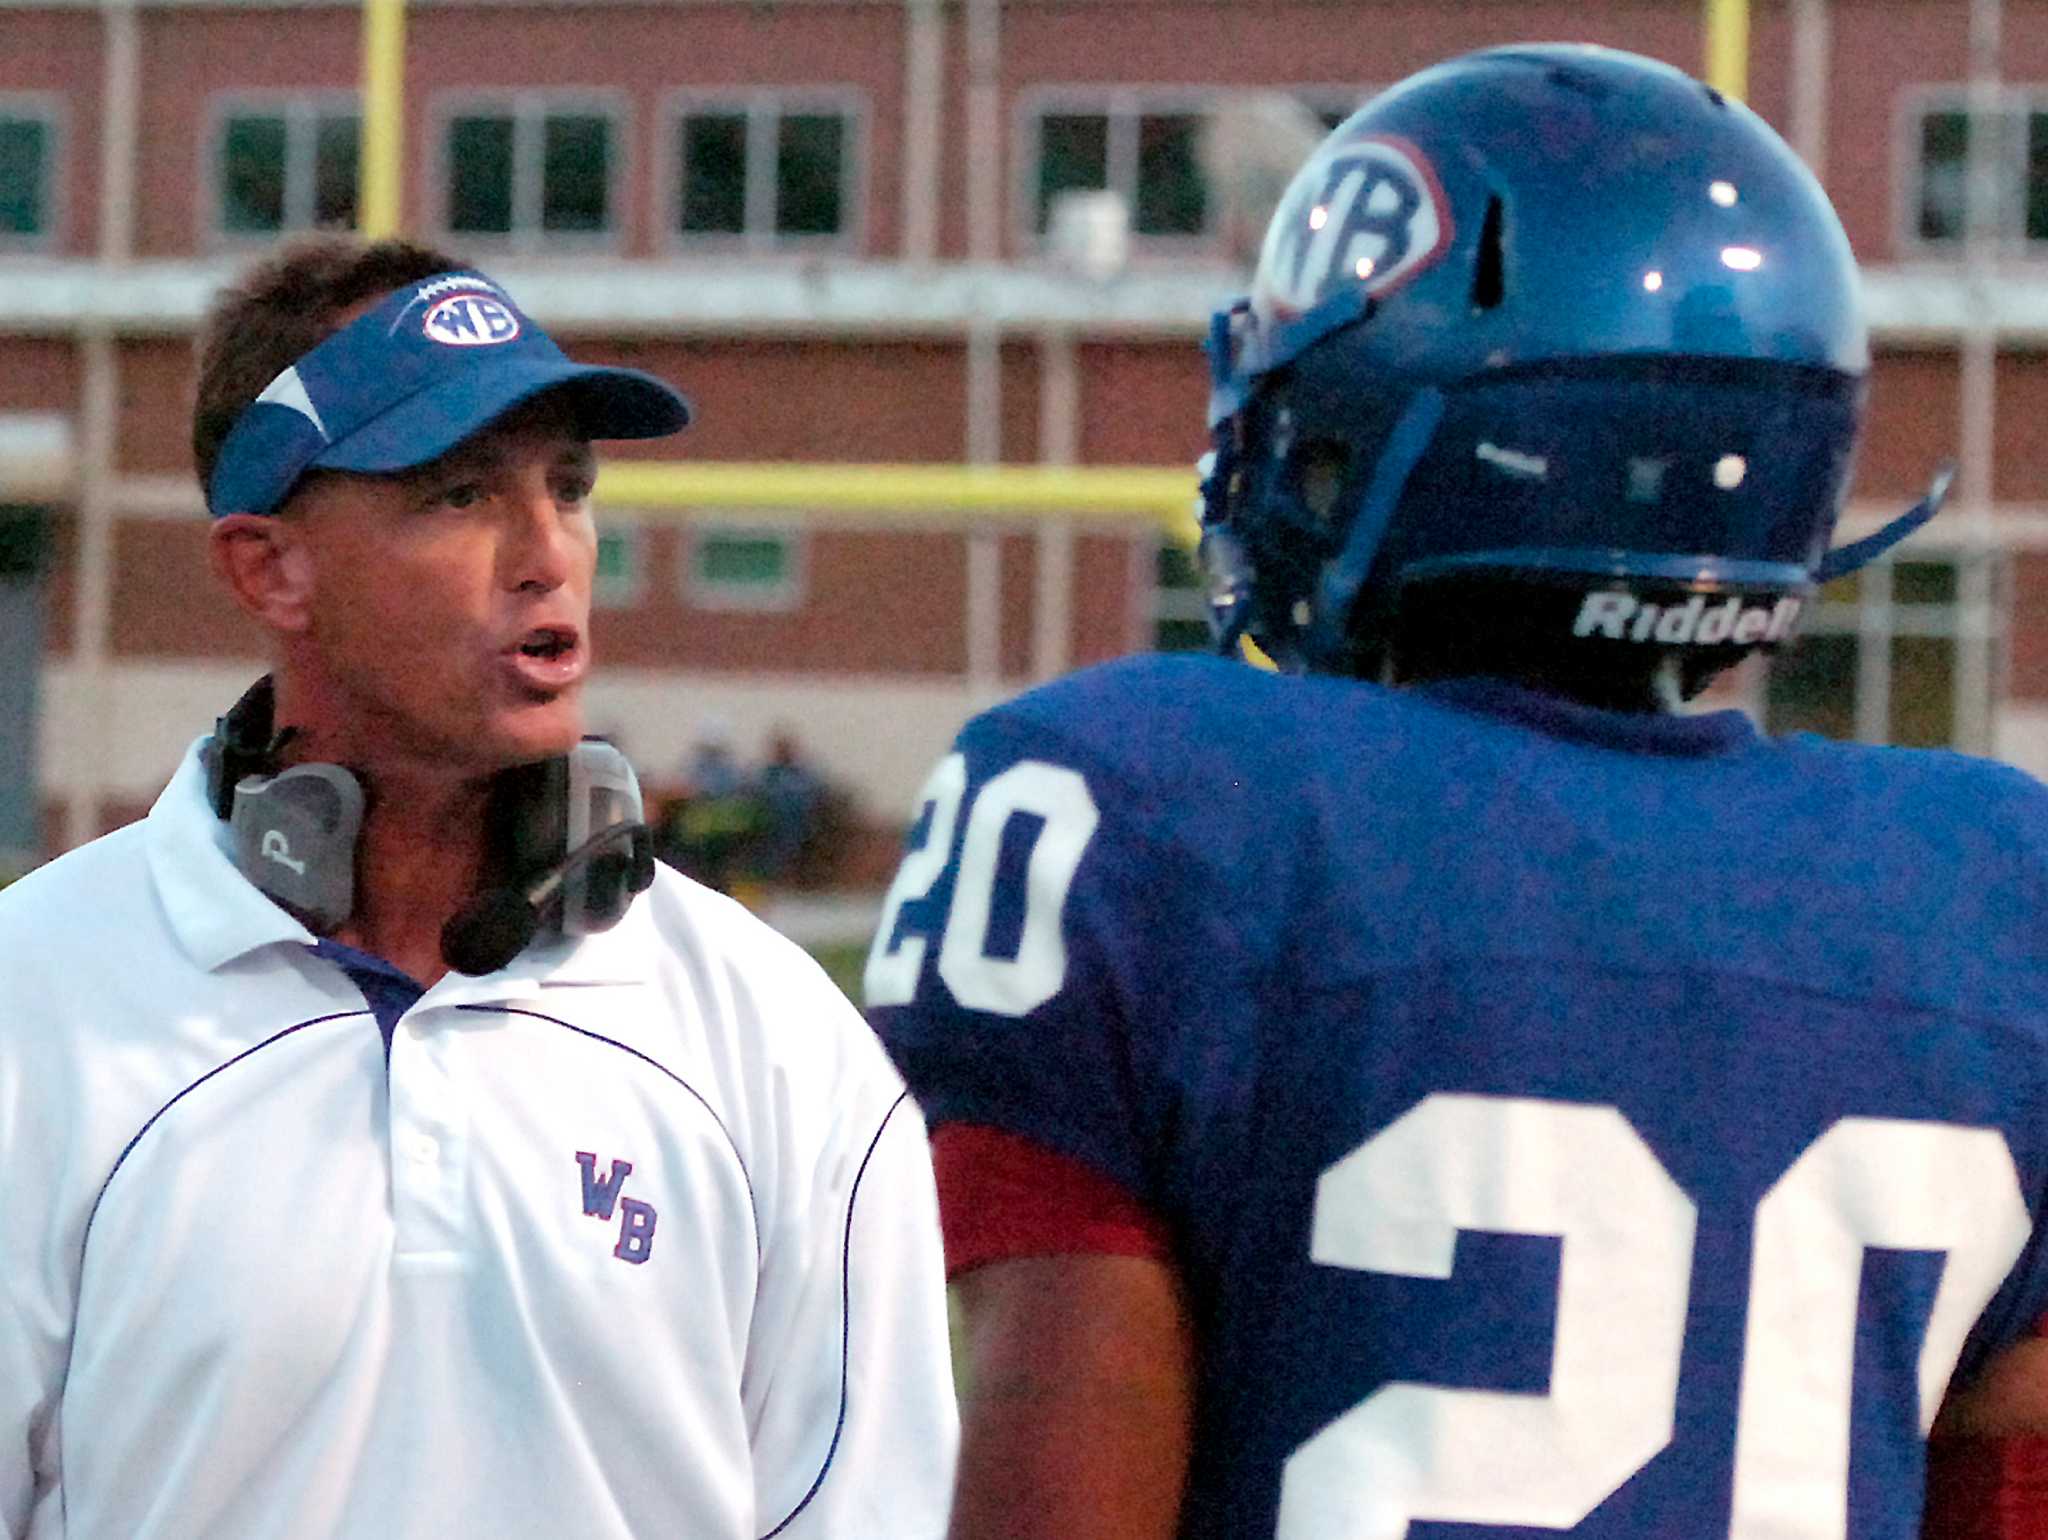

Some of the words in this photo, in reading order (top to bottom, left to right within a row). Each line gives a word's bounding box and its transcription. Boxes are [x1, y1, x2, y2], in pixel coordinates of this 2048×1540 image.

[431, 299, 513, 339] WB
[863, 752, 1101, 1018] 20
[1275, 1093, 2034, 1540] 20
